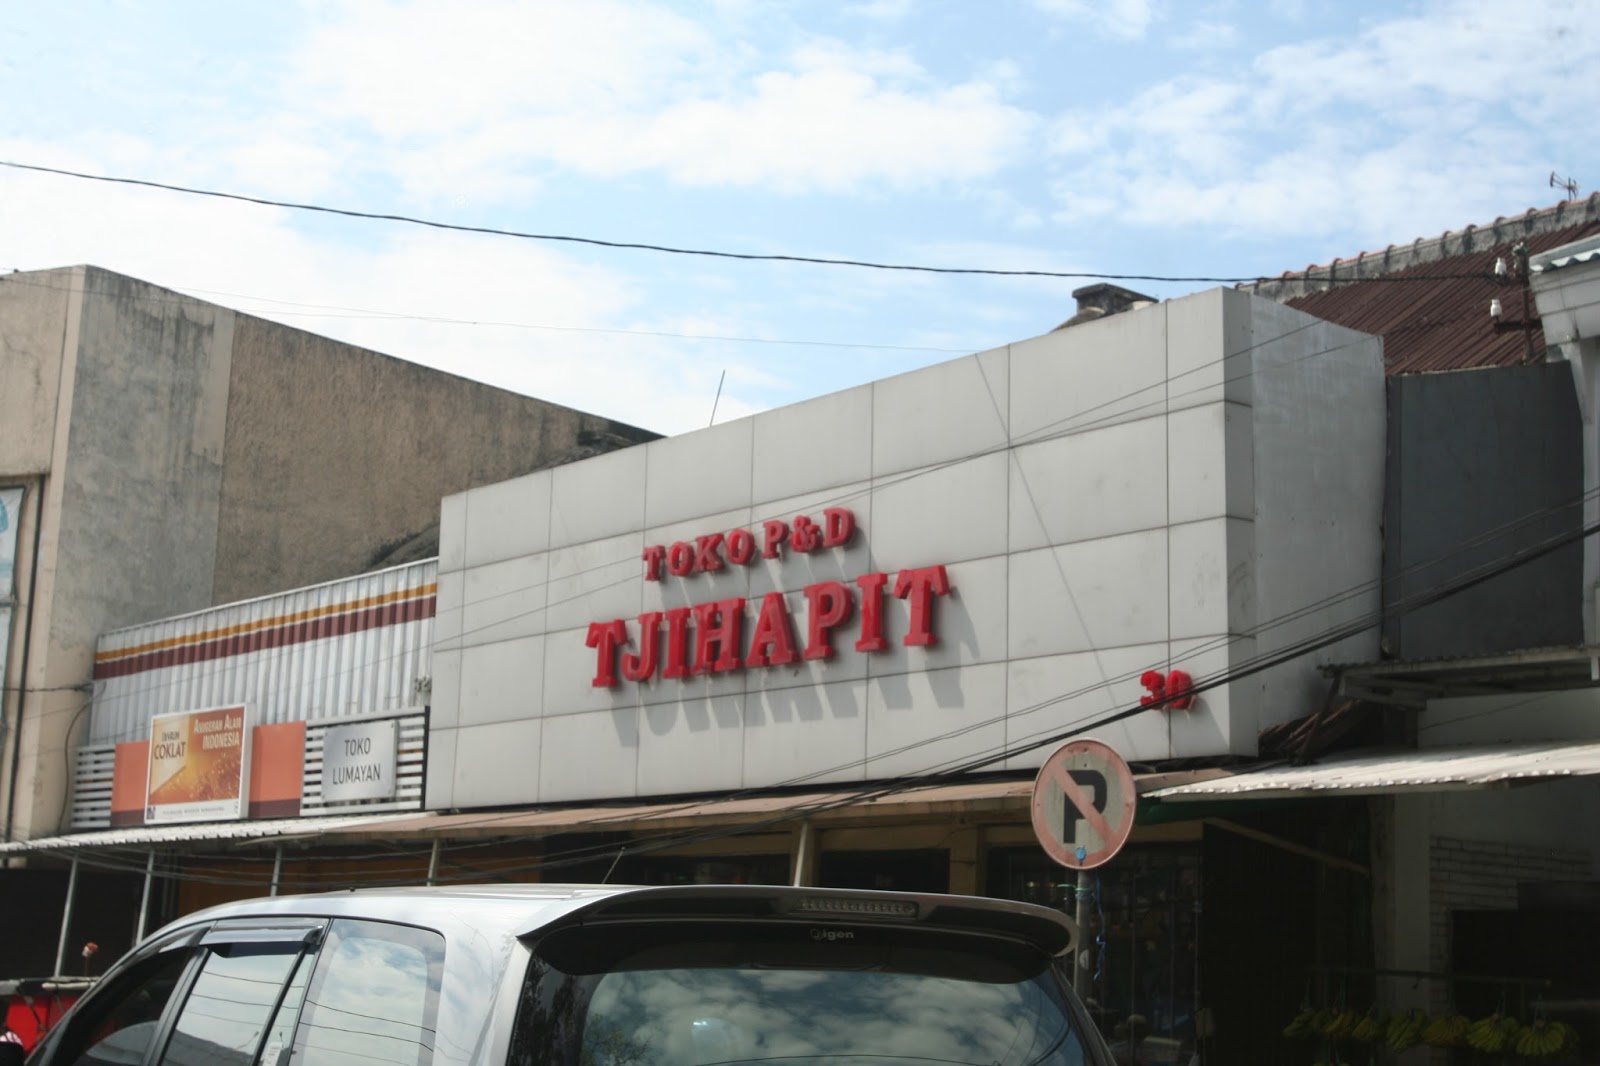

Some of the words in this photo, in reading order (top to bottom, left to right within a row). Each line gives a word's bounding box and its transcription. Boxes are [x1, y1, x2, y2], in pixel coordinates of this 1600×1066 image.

[643, 528, 756, 582] TOKO
[763, 507, 856, 560] P&D
[585, 565, 952, 688] TJIHAPIT
[154, 742, 186, 760] COKLAT
[203, 731, 240, 751] INDONESIA
[344, 737, 371, 757] TOKO
[332, 763, 381, 785] LUMAYAN
